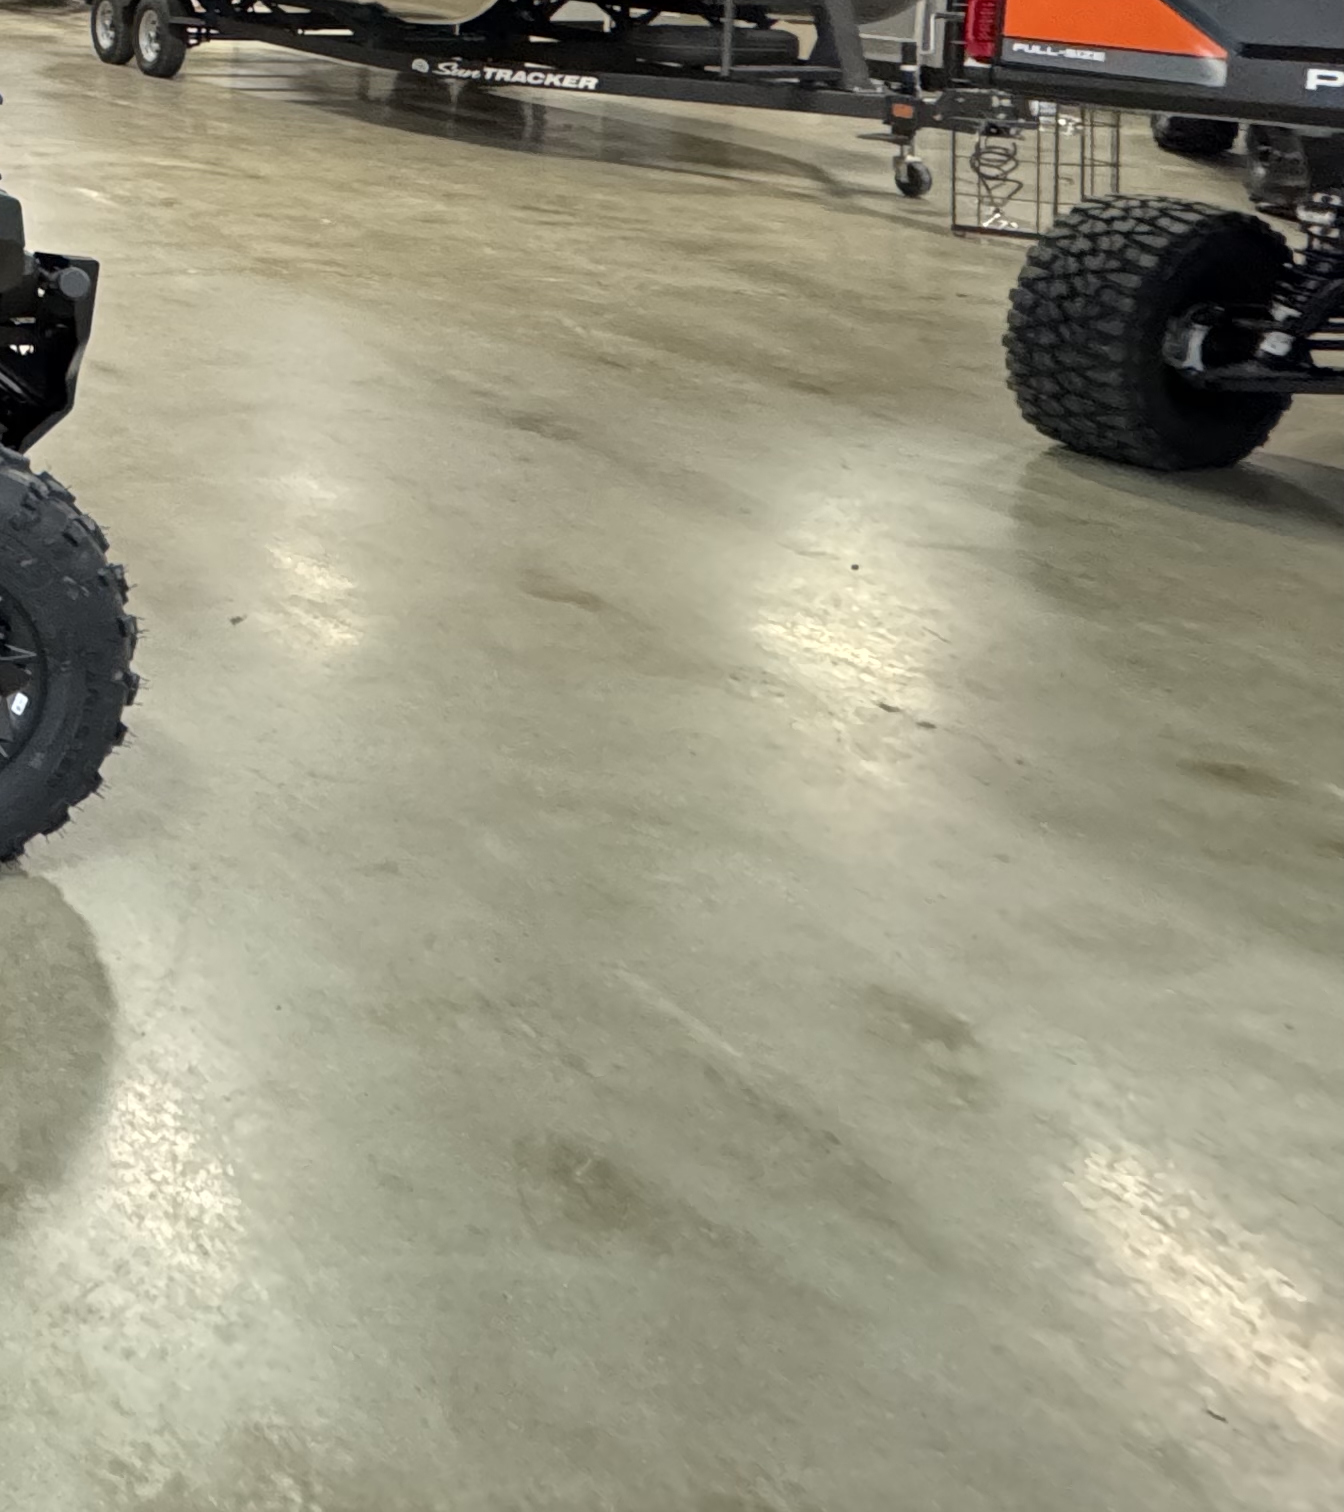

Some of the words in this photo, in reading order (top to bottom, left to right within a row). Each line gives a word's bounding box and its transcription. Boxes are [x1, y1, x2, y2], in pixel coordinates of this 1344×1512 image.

[1012, 42, 1106, 63] FULL-SIZE
[432, 61, 481, 79] Sun
[483, 66, 599, 91] TRACKER
